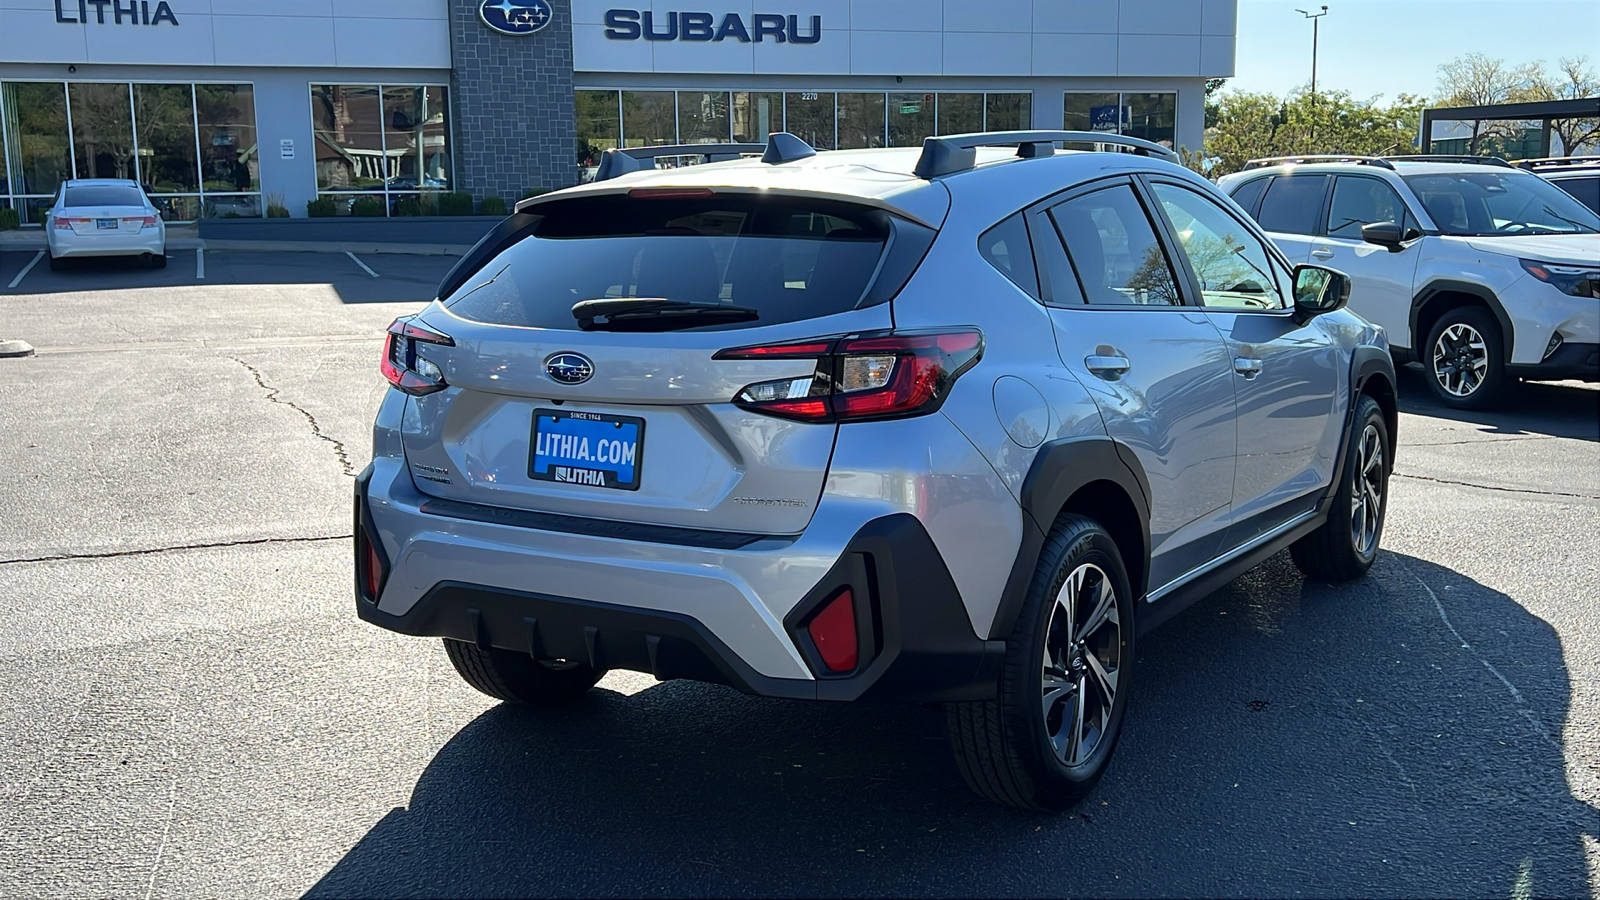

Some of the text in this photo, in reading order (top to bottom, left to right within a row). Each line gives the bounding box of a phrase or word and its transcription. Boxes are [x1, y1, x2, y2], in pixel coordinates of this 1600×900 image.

[54, 0, 179, 26] LITHIA
[604, 9, 821, 44] SUBARU
[801, 92, 818, 101] 2270
[570, 412, 602, 421] SINCE 1946
[535, 432, 637, 466] LITHIA.COM
[566, 467, 606, 486] LITHIA
